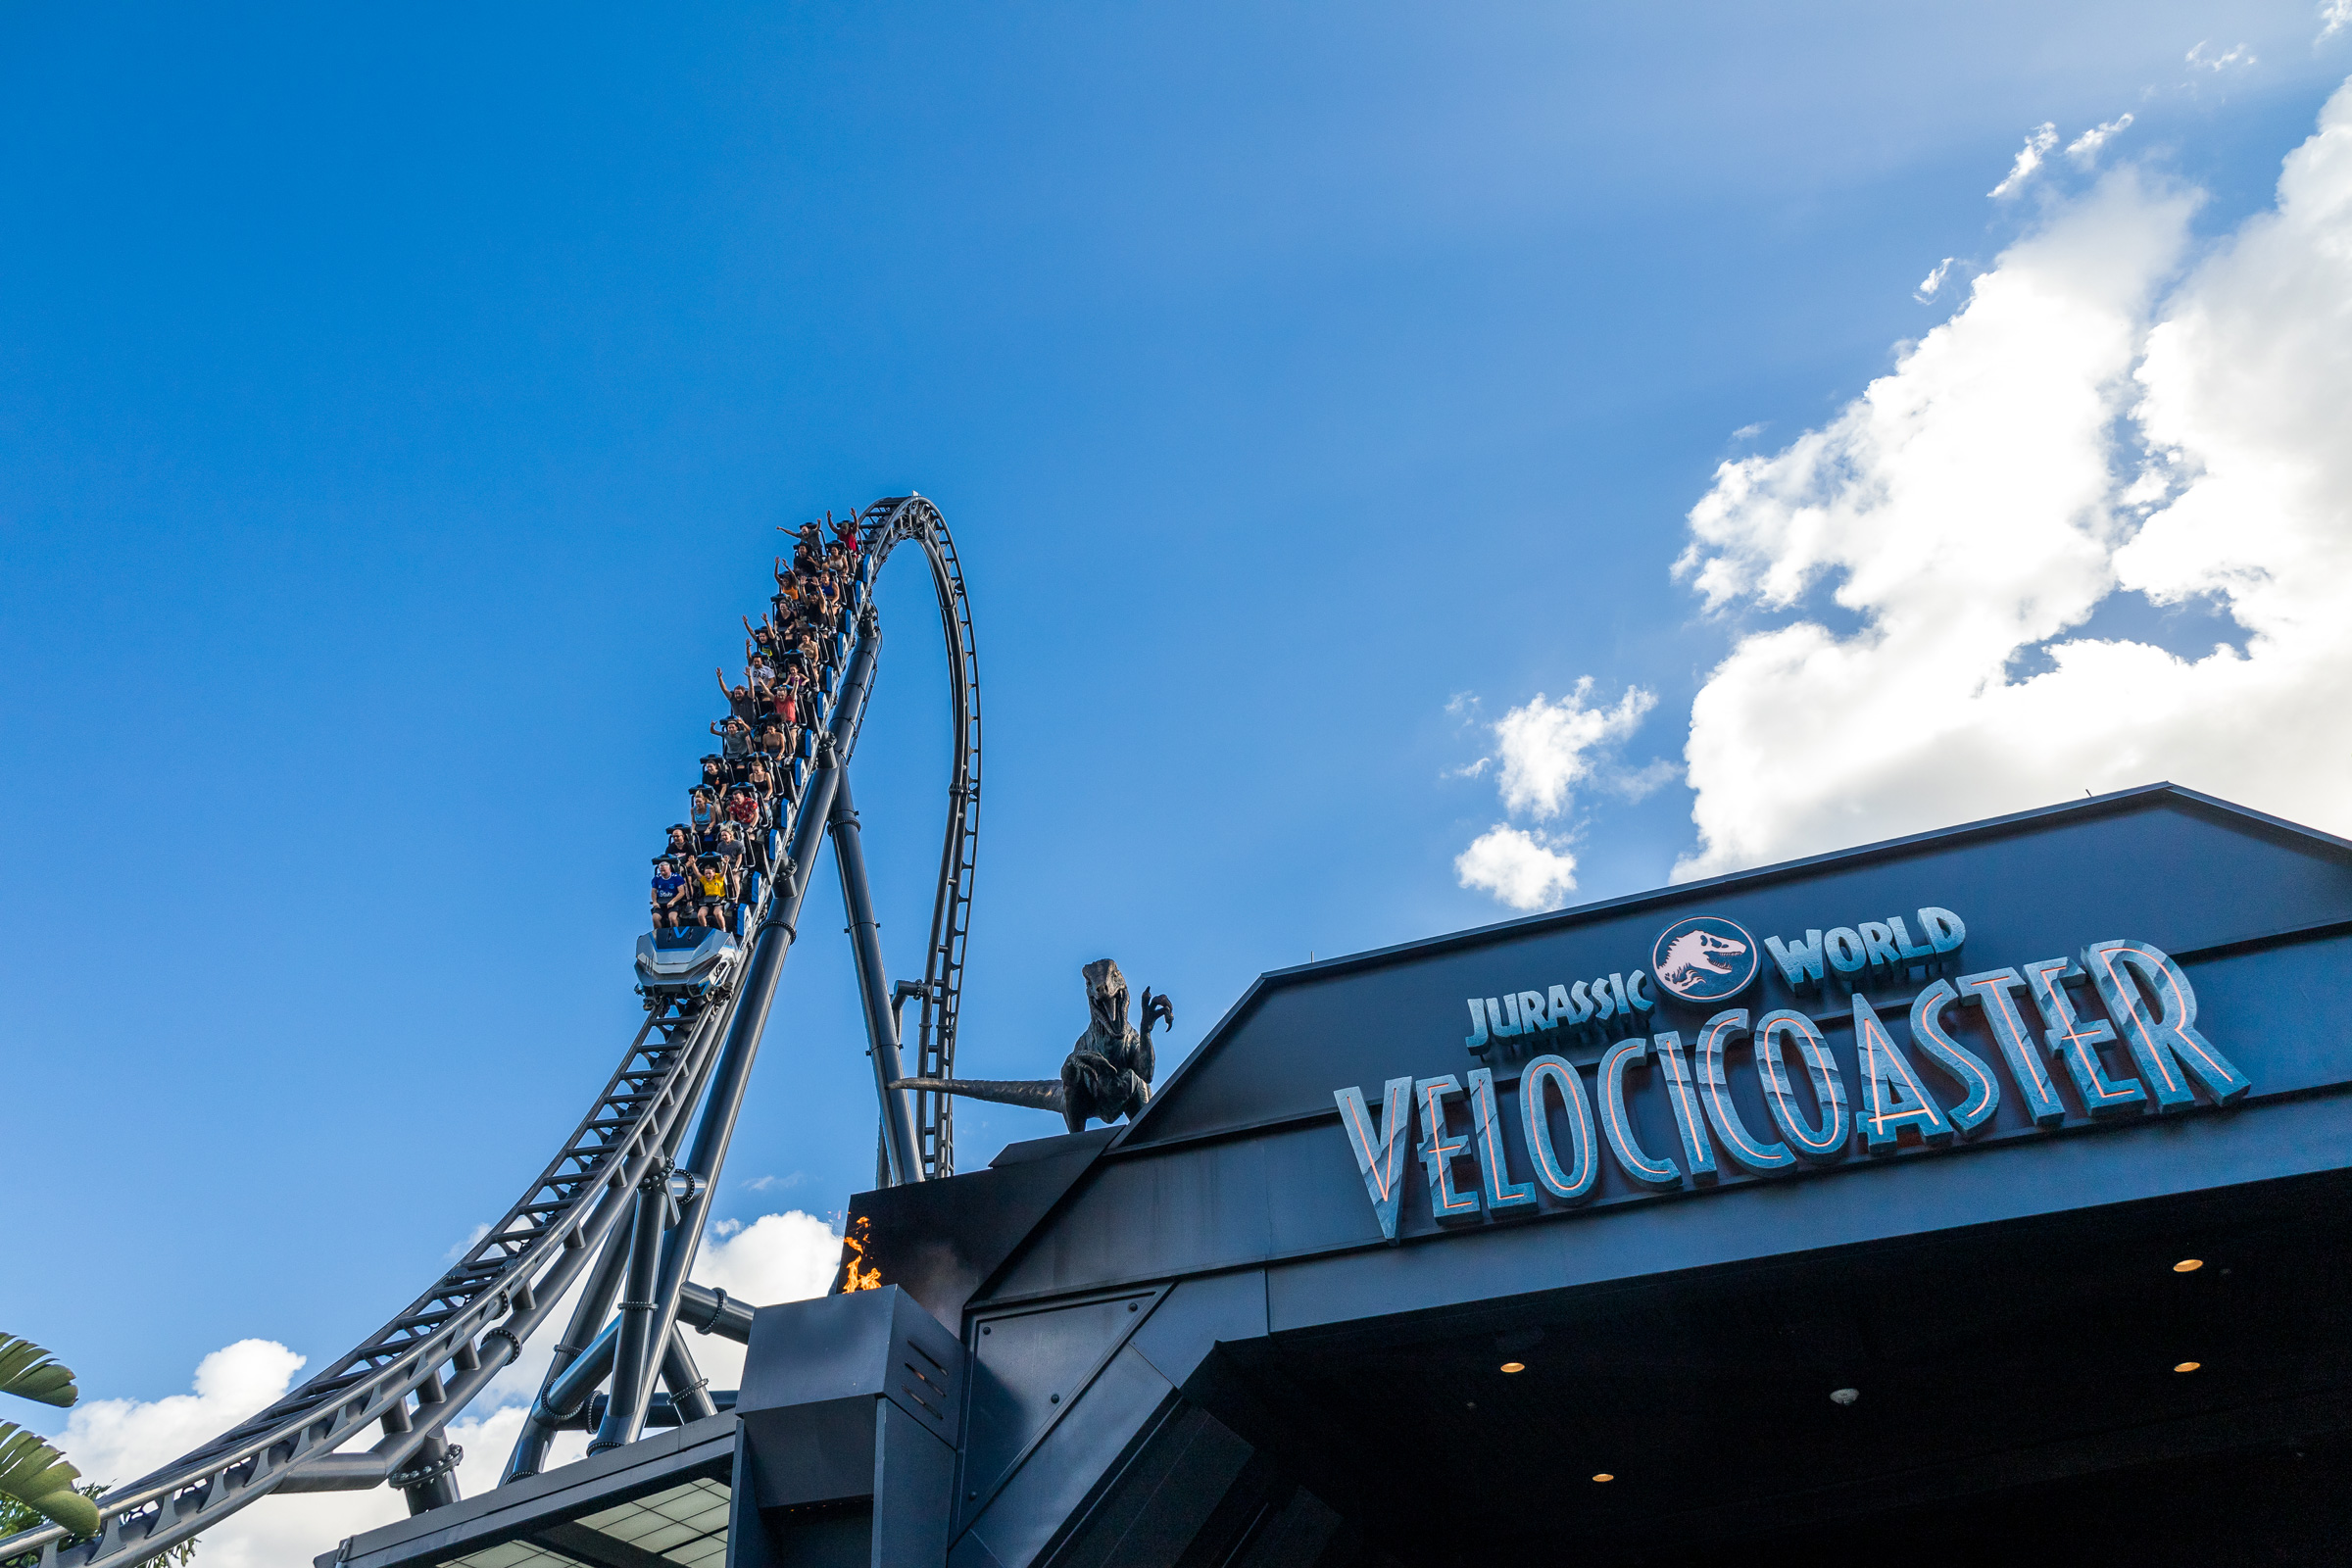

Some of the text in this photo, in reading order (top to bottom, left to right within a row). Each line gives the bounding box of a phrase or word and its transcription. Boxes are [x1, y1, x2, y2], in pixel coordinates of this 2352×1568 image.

[1334, 939, 2251, 1244] VELOCICOASTER
[1465, 906, 1966, 1053] JURASSIC WORLD
